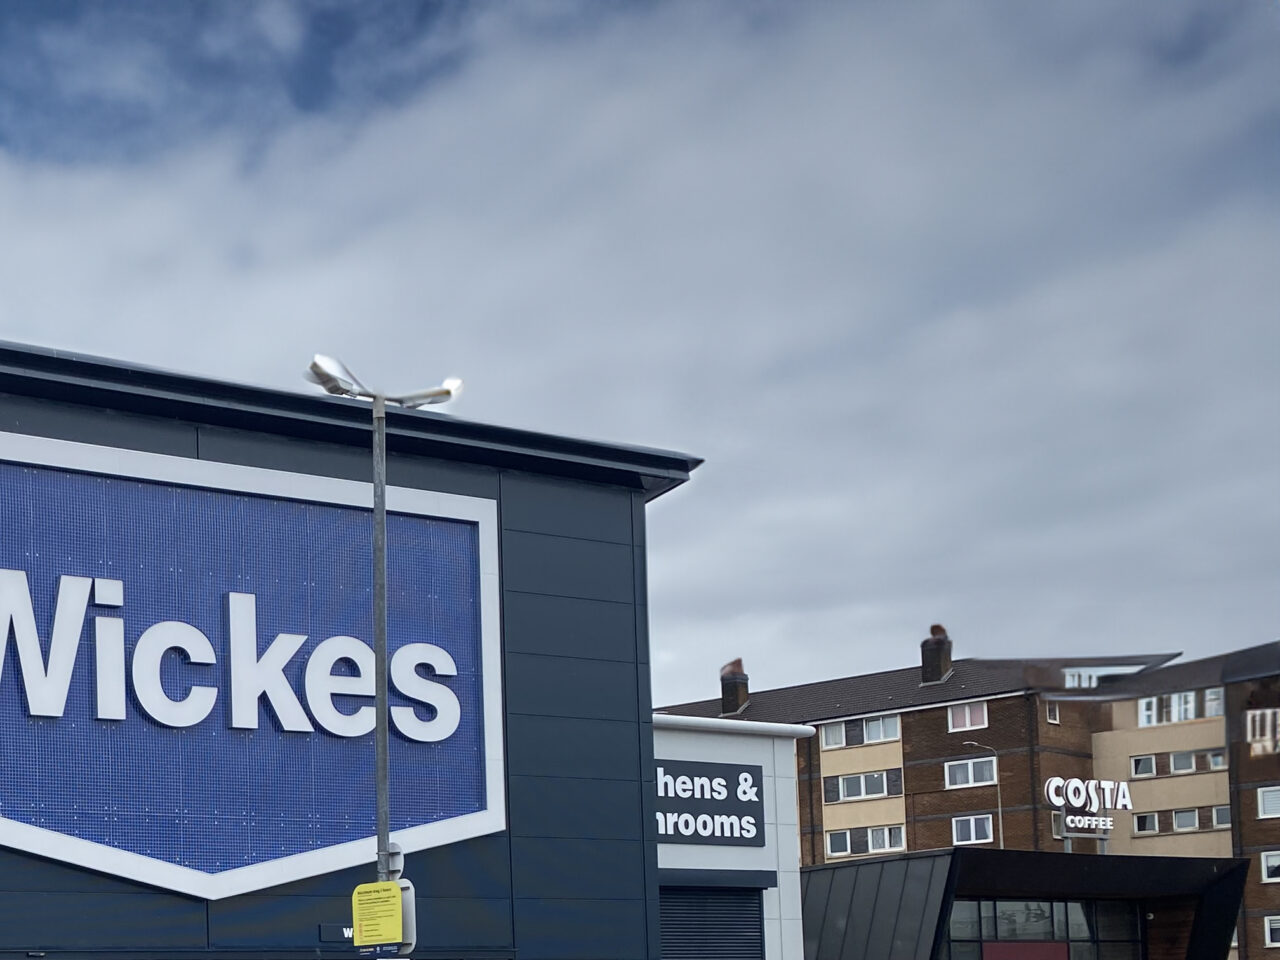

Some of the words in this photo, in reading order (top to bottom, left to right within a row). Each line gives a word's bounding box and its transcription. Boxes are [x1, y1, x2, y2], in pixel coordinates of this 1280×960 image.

[736, 772, 760, 802] &
[1045, 776, 1133, 813] COSTA
[1065, 815, 1114, 829] COFFEE
